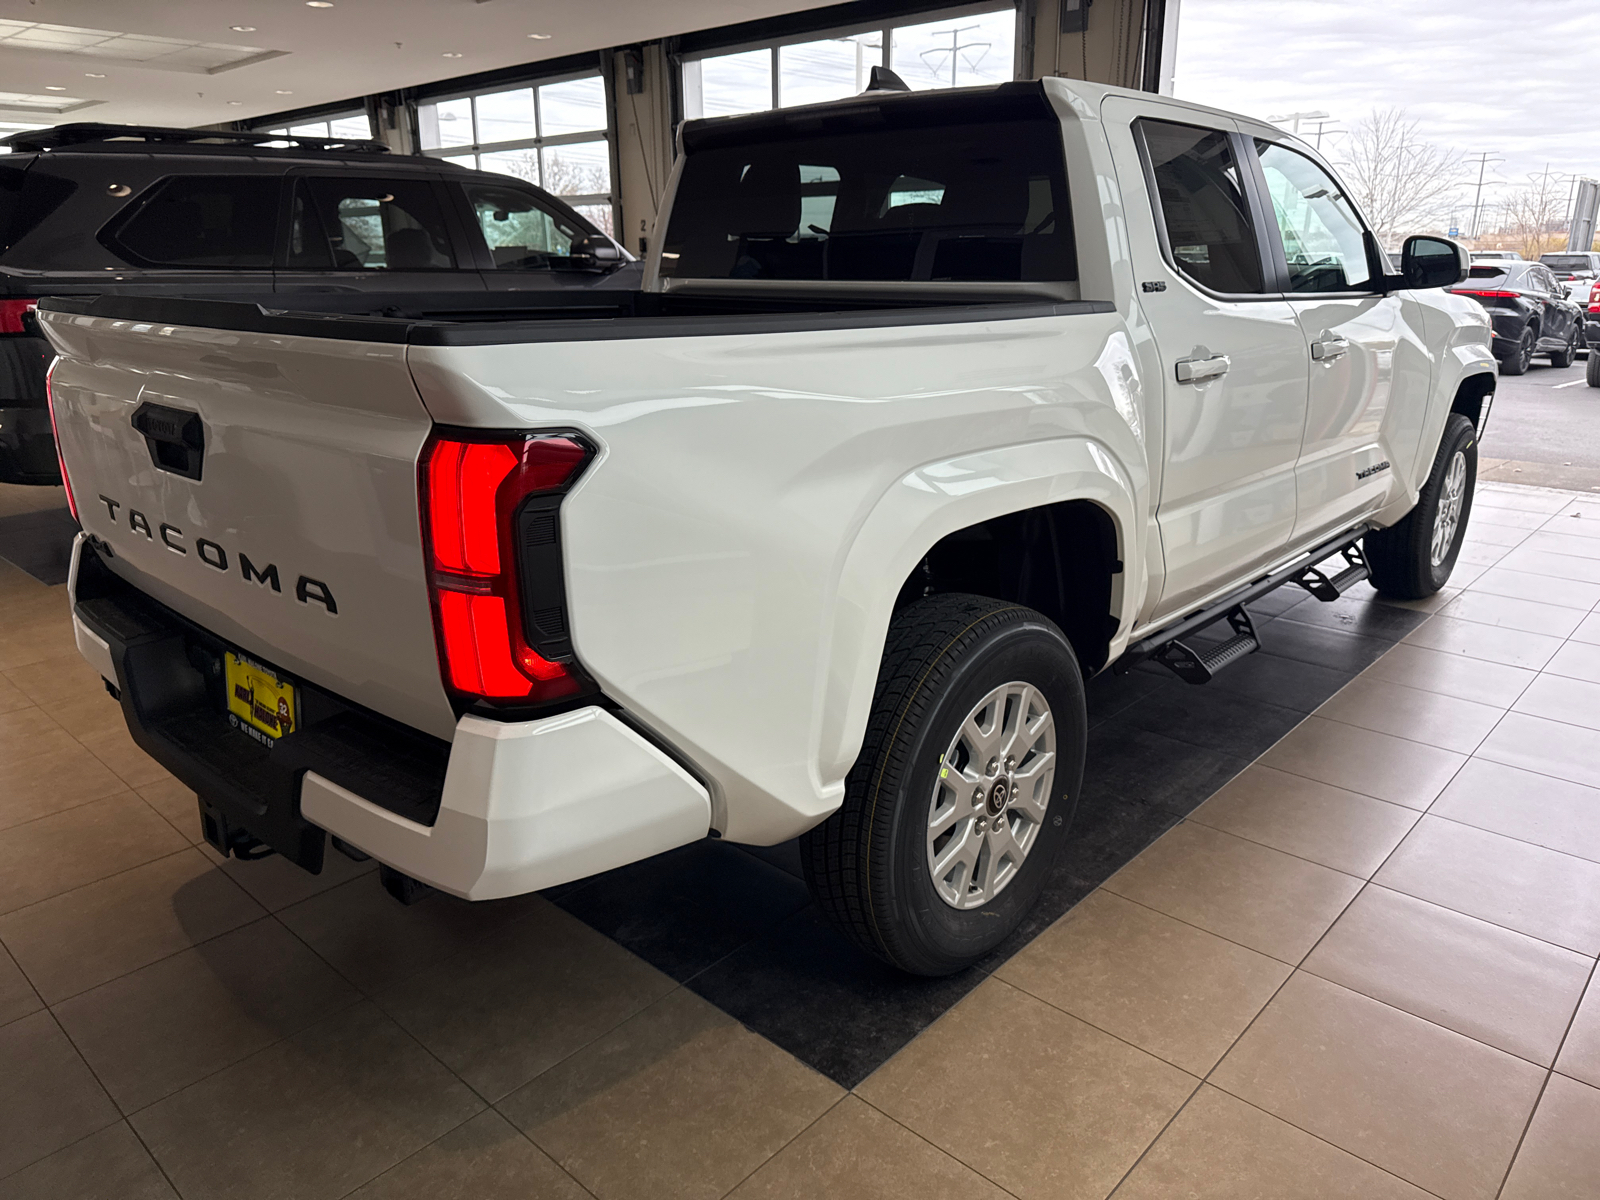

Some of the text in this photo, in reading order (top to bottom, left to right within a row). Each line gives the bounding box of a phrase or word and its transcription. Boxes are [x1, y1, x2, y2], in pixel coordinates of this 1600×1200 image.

[641, 219, 646, 231] 2
[1141, 281, 1167, 293] SR5
[1355, 460, 1391, 480] TACOMA
[99, 493, 338, 616] TACOMA
